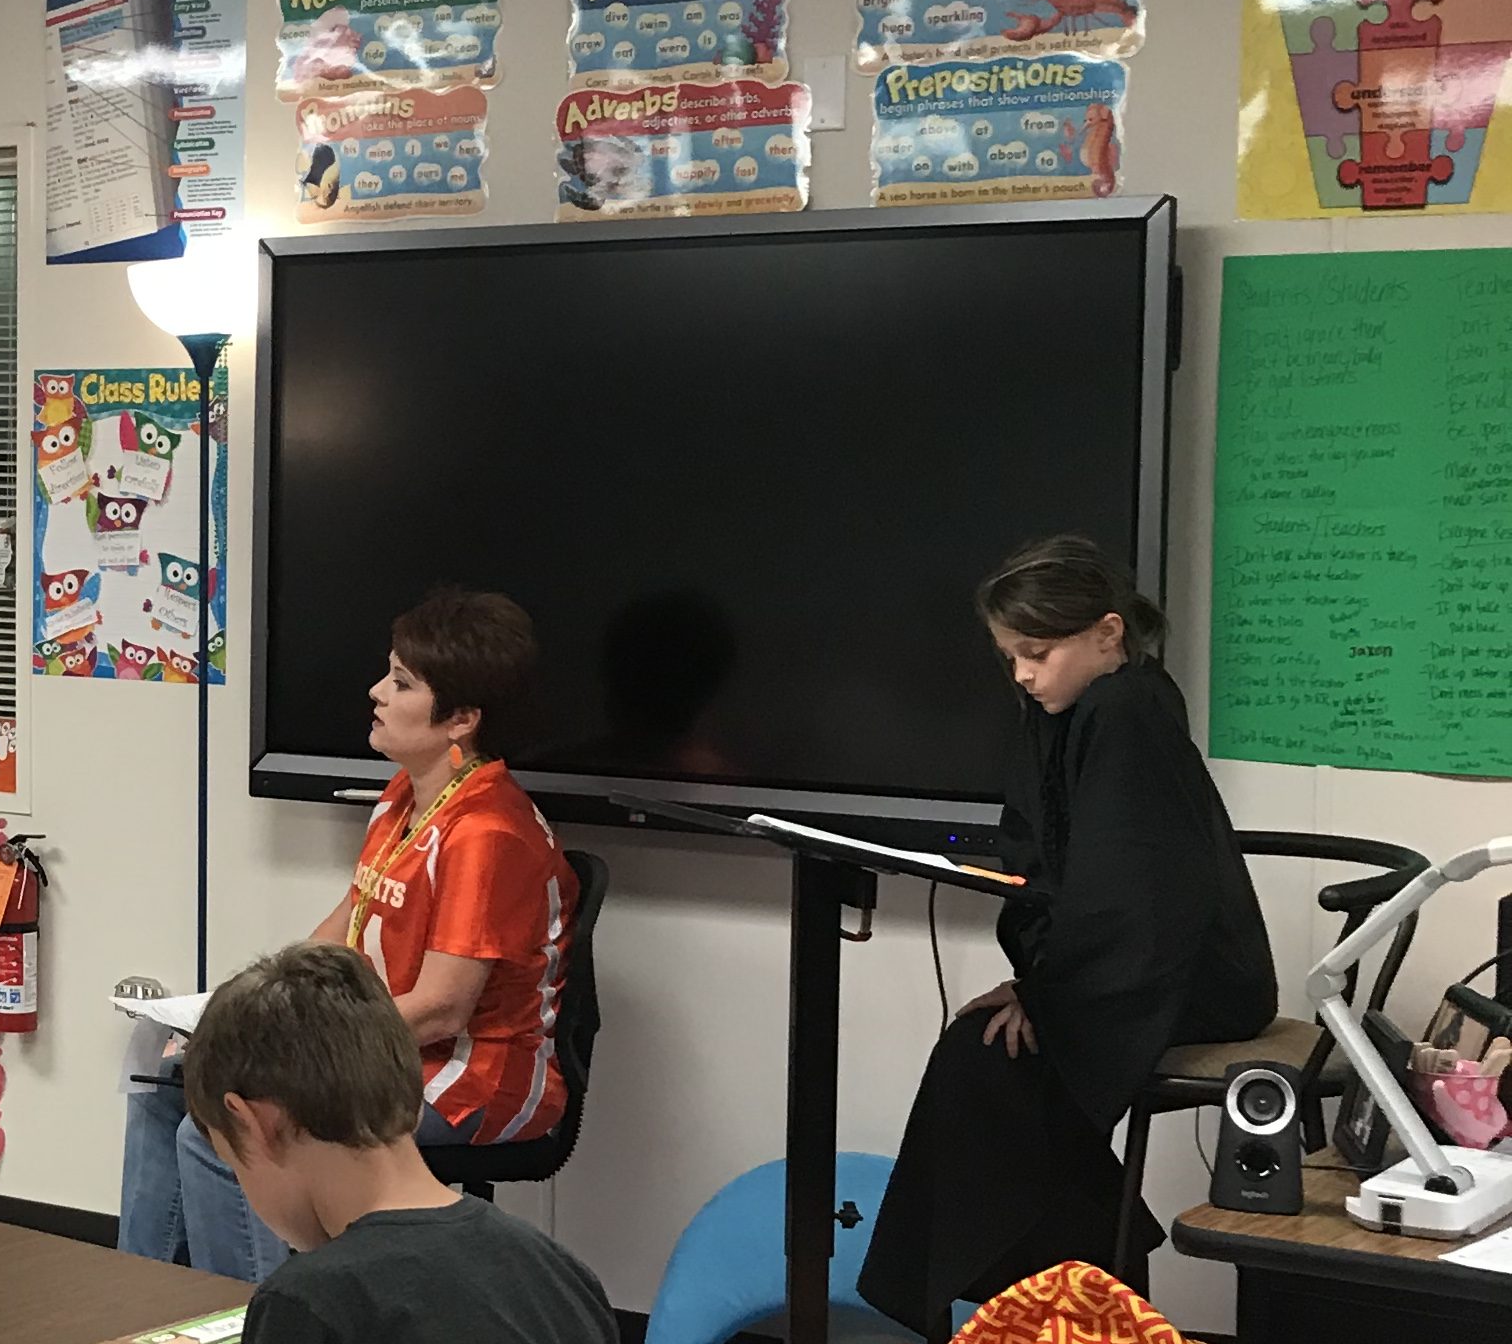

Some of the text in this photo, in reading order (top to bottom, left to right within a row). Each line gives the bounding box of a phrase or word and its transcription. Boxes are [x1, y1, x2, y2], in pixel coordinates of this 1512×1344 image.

[605, 12, 628, 23] dive
[686, 12, 703, 21] am
[719, 12, 741, 22] was
[926, 9, 984, 26] sparkling
[639, 19, 669, 31] swim
[882, 22, 913, 36] huge
[659, 42, 688, 53] were
[886, 61, 1085, 104] Prepositions
[565, 88, 728, 134] Adverbs describe
[879, 102, 914, 118] begin
[917, 98, 964, 113] phrases
[968, 93, 993, 108] that
[996, 91, 1031, 106] show
[975, 124, 989, 137] at
[1024, 118, 1056, 131] from
[989, 148, 1028, 162] about
[1040, 156, 1055, 167] to
[735, 165, 757, 178] fast
[947, 159, 975, 173] with
[358, 178, 380, 191] they
[80, 373, 145, 405] Class
